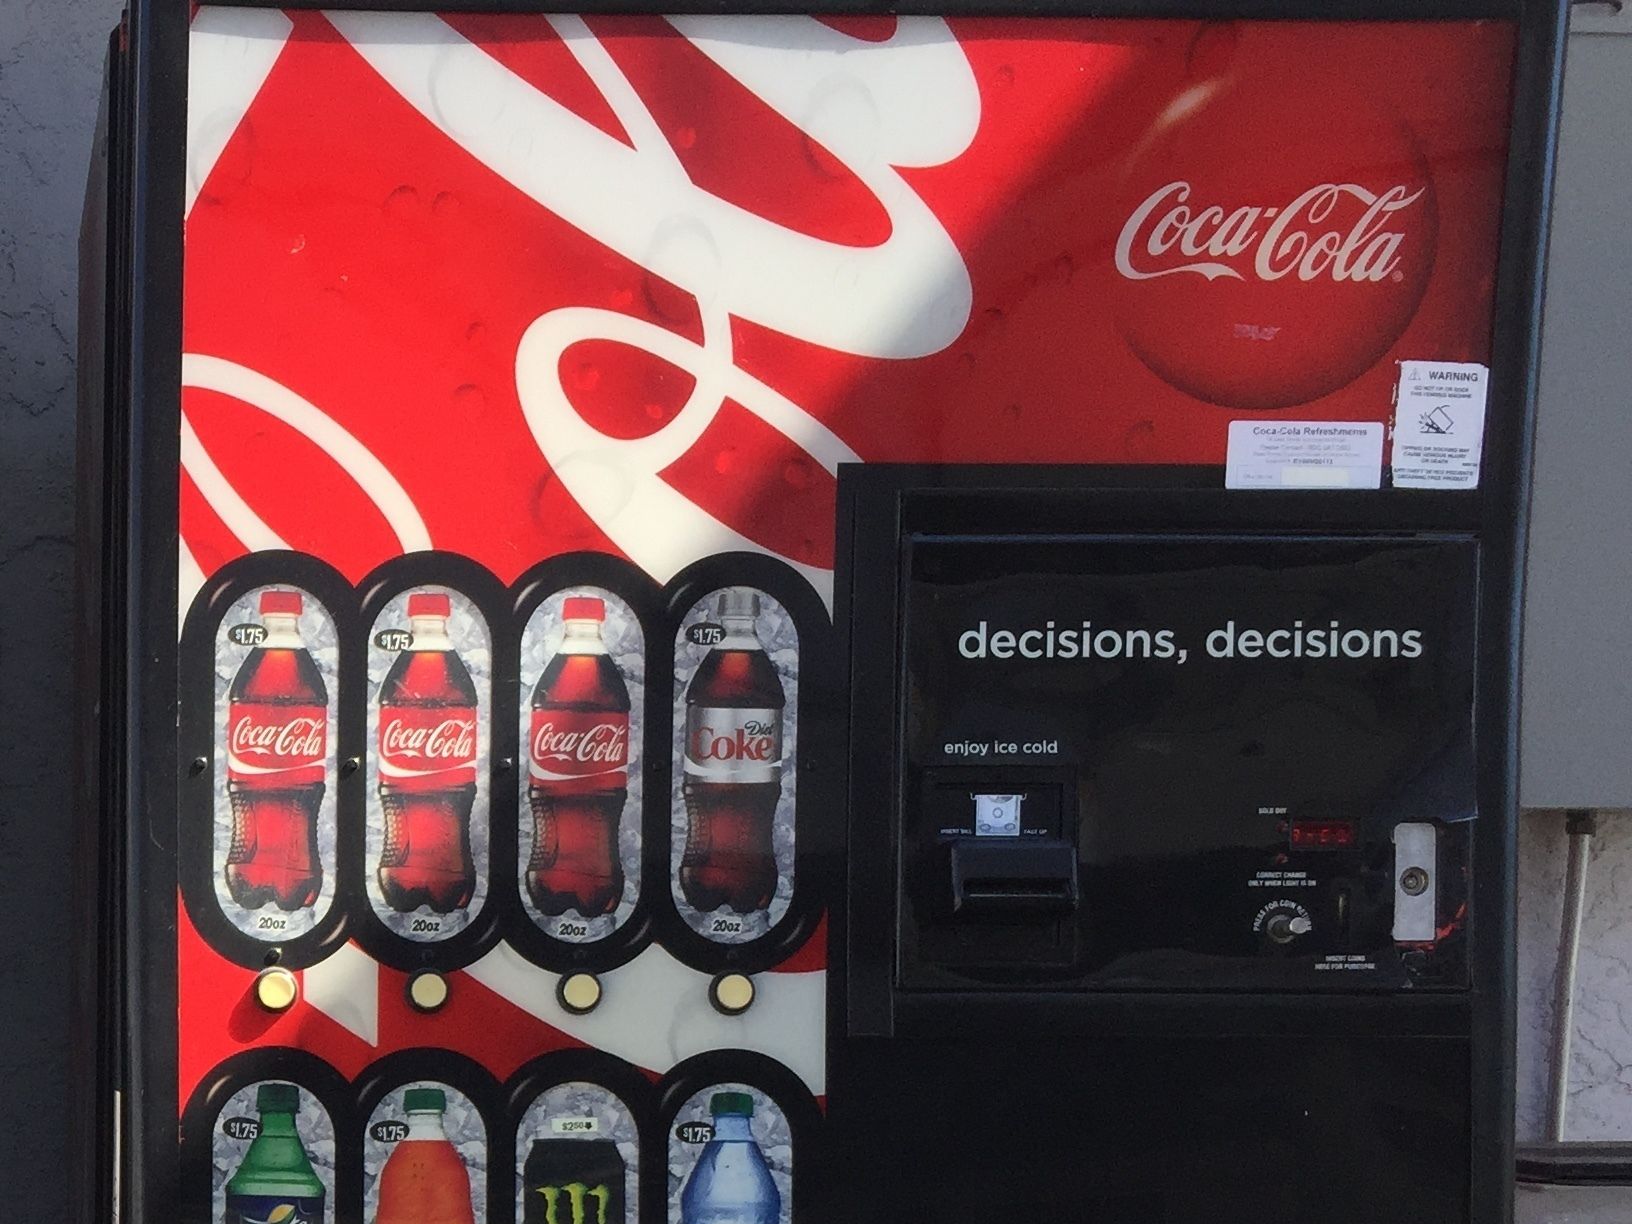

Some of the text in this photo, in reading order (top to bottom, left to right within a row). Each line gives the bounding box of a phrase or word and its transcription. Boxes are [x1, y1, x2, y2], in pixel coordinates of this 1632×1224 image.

[1114, 180, 1426, 282] Coca-Cola
[1428, 370, 1479, 382] WARNING
[1252, 426, 1301, 436] Coca-Cola
[235, 627, 264, 646] $1.75
[381, 633, 410, 652] $1.75
[693, 627, 721, 645] $1.75
[957, 620, 1424, 665] decisions, decisions
[232, 716, 325, 757] Coca-Cola
[744, 720, 775, 737] Diet
[382, 718, 476, 758] Coca-Cola
[533, 722, 626, 763] Coca-Cola
[691, 726, 776, 762] Coke
[944, 740, 1059, 757] enjoy ice cold
[257, 916, 287, 932] 20oz
[411, 918, 441, 934] 20oz
[558, 922, 588, 938] 20oz
[713, 918, 742, 934] 20oz
[230, 1122, 258, 1139] $1.75
[377, 1125, 405, 1141] $1.75
[682, 1126, 711, 1142] $1.75
